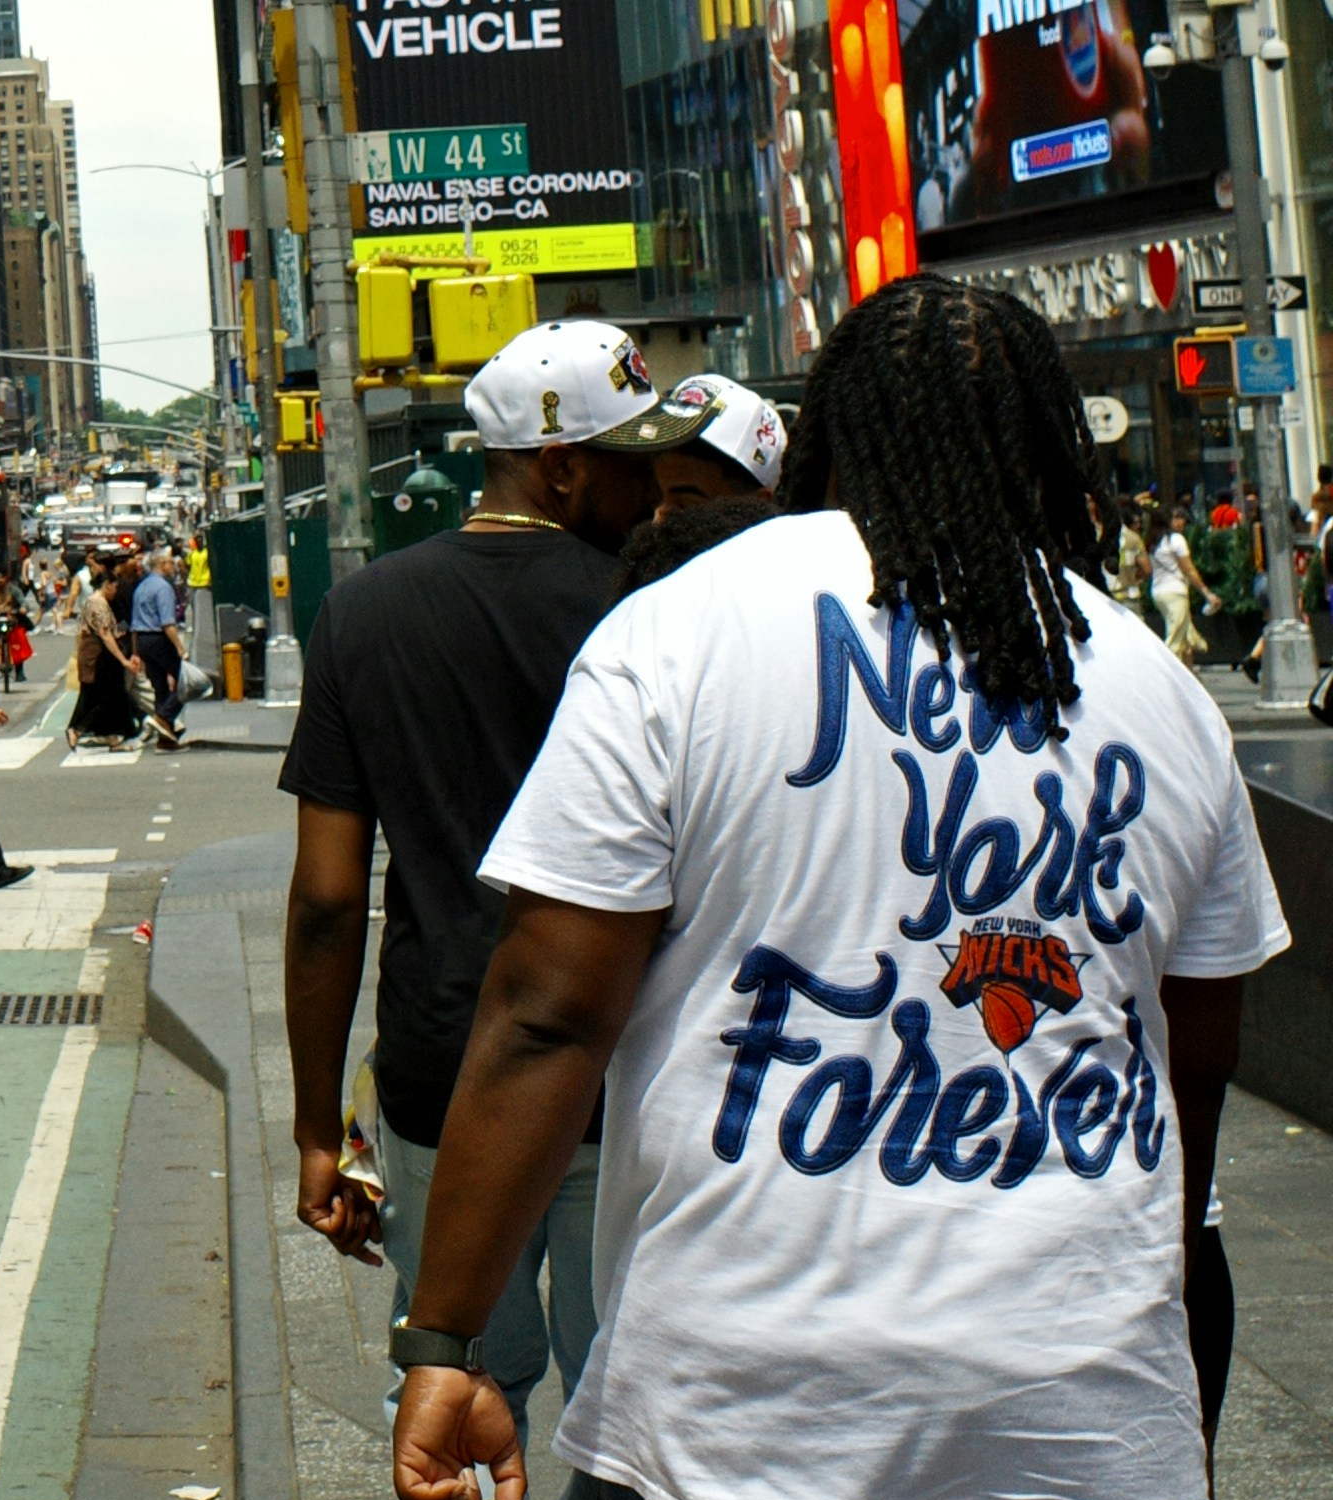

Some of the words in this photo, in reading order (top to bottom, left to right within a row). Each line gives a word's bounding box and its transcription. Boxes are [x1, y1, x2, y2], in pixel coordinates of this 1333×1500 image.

[356, 7, 563, 60] VEHICLE
[396, 137, 425, 175] W
[443, 131, 487, 172] 44
[501, 129, 523, 156] St
[368, 179, 442, 204] NAVAL
[443, 176, 506, 200] BASE
[368, 204, 419, 230] SAN
[500, 238, 539, 253] 06.21
[500, 252, 539, 266] 2026
[1267, 284, 1291, 304] AY
[785, 587, 1045, 789] New
[891, 740, 1147, 946] York
[971, 916, 1005, 934] NEW
[1006, 918, 1043, 939] YORK
[712, 943, 1167, 1190] Forever
